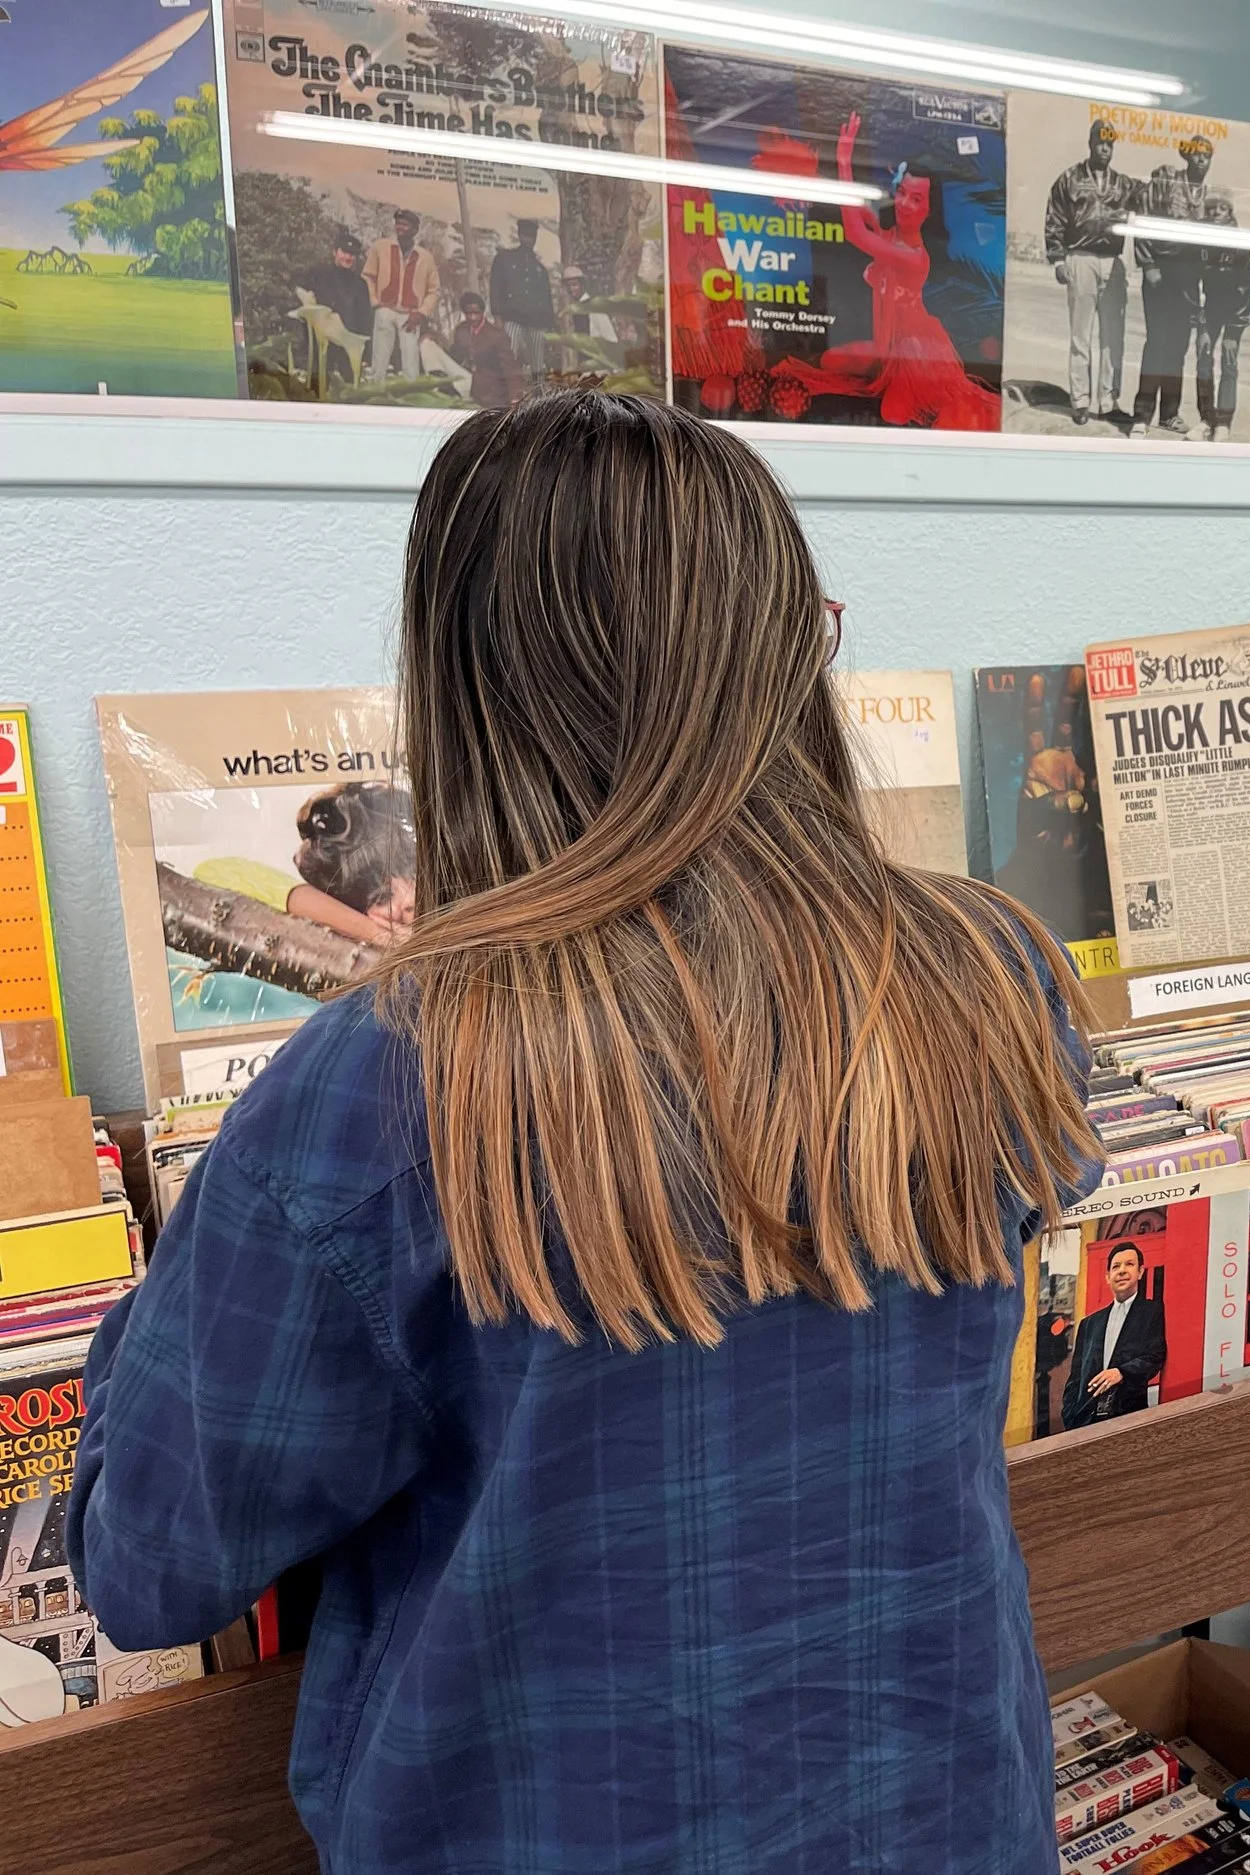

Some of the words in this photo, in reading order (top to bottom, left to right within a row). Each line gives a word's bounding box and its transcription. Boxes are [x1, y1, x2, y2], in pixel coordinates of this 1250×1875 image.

[268, 35, 341, 83] The
[345, 44, 508, 104] Chambers
[508, 67, 646, 122] Brothers
[302, 82, 373, 123] The
[1170, 114, 1228, 139] MOTION
[683, 201, 845, 244] Hawaiian
[718, 237, 797, 273] War
[701, 267, 810, 306] Chant
[727, 317, 749, 328] and
[751, 318, 770, 330] His
[773, 320, 826, 334] Orchestra
[754, 308, 796, 322] Tommy
[799, 311, 837, 325] Dorsey
[1088, 650, 1133, 670] JETHRO
[1090, 668, 1134, 695] TULL
[858, 695, 937, 725] FOUR
[1105, 702, 1212, 758] THICK
[223, 748, 329, 777] what's
[337, 751, 375, 772] an
[1112, 756, 1147, 772] JUDGES
[1150, 751, 1199, 768] DISQUALIFY
[1152, 768, 1162, 780] IN
[1164, 765, 1186, 779] LAST
[1188, 763, 1221, 776] MINUTE
[1120, 788, 1134, 801] ART
[1136, 787, 1158, 798] DEMO
[1125, 800, 1154, 811] FORCES
[1125, 812, 1158, 824] CLOSURE
[1074, 944, 1119, 972] NTR
[1154, 977, 1215, 997] FOREIGN
[1119, 1187, 1185, 1209] SOUND
[159, 1651, 178, 1663] WITH
[1066, 1839, 1106, 1865] FOOTBALL
[1106, 1827, 1136, 1848] FOLLIES
[1076, 1832, 1100, 1851] SUPER
[1101, 1821, 1128, 1841] DUPER
[1093, 1832, 1177, 1873] Hook
